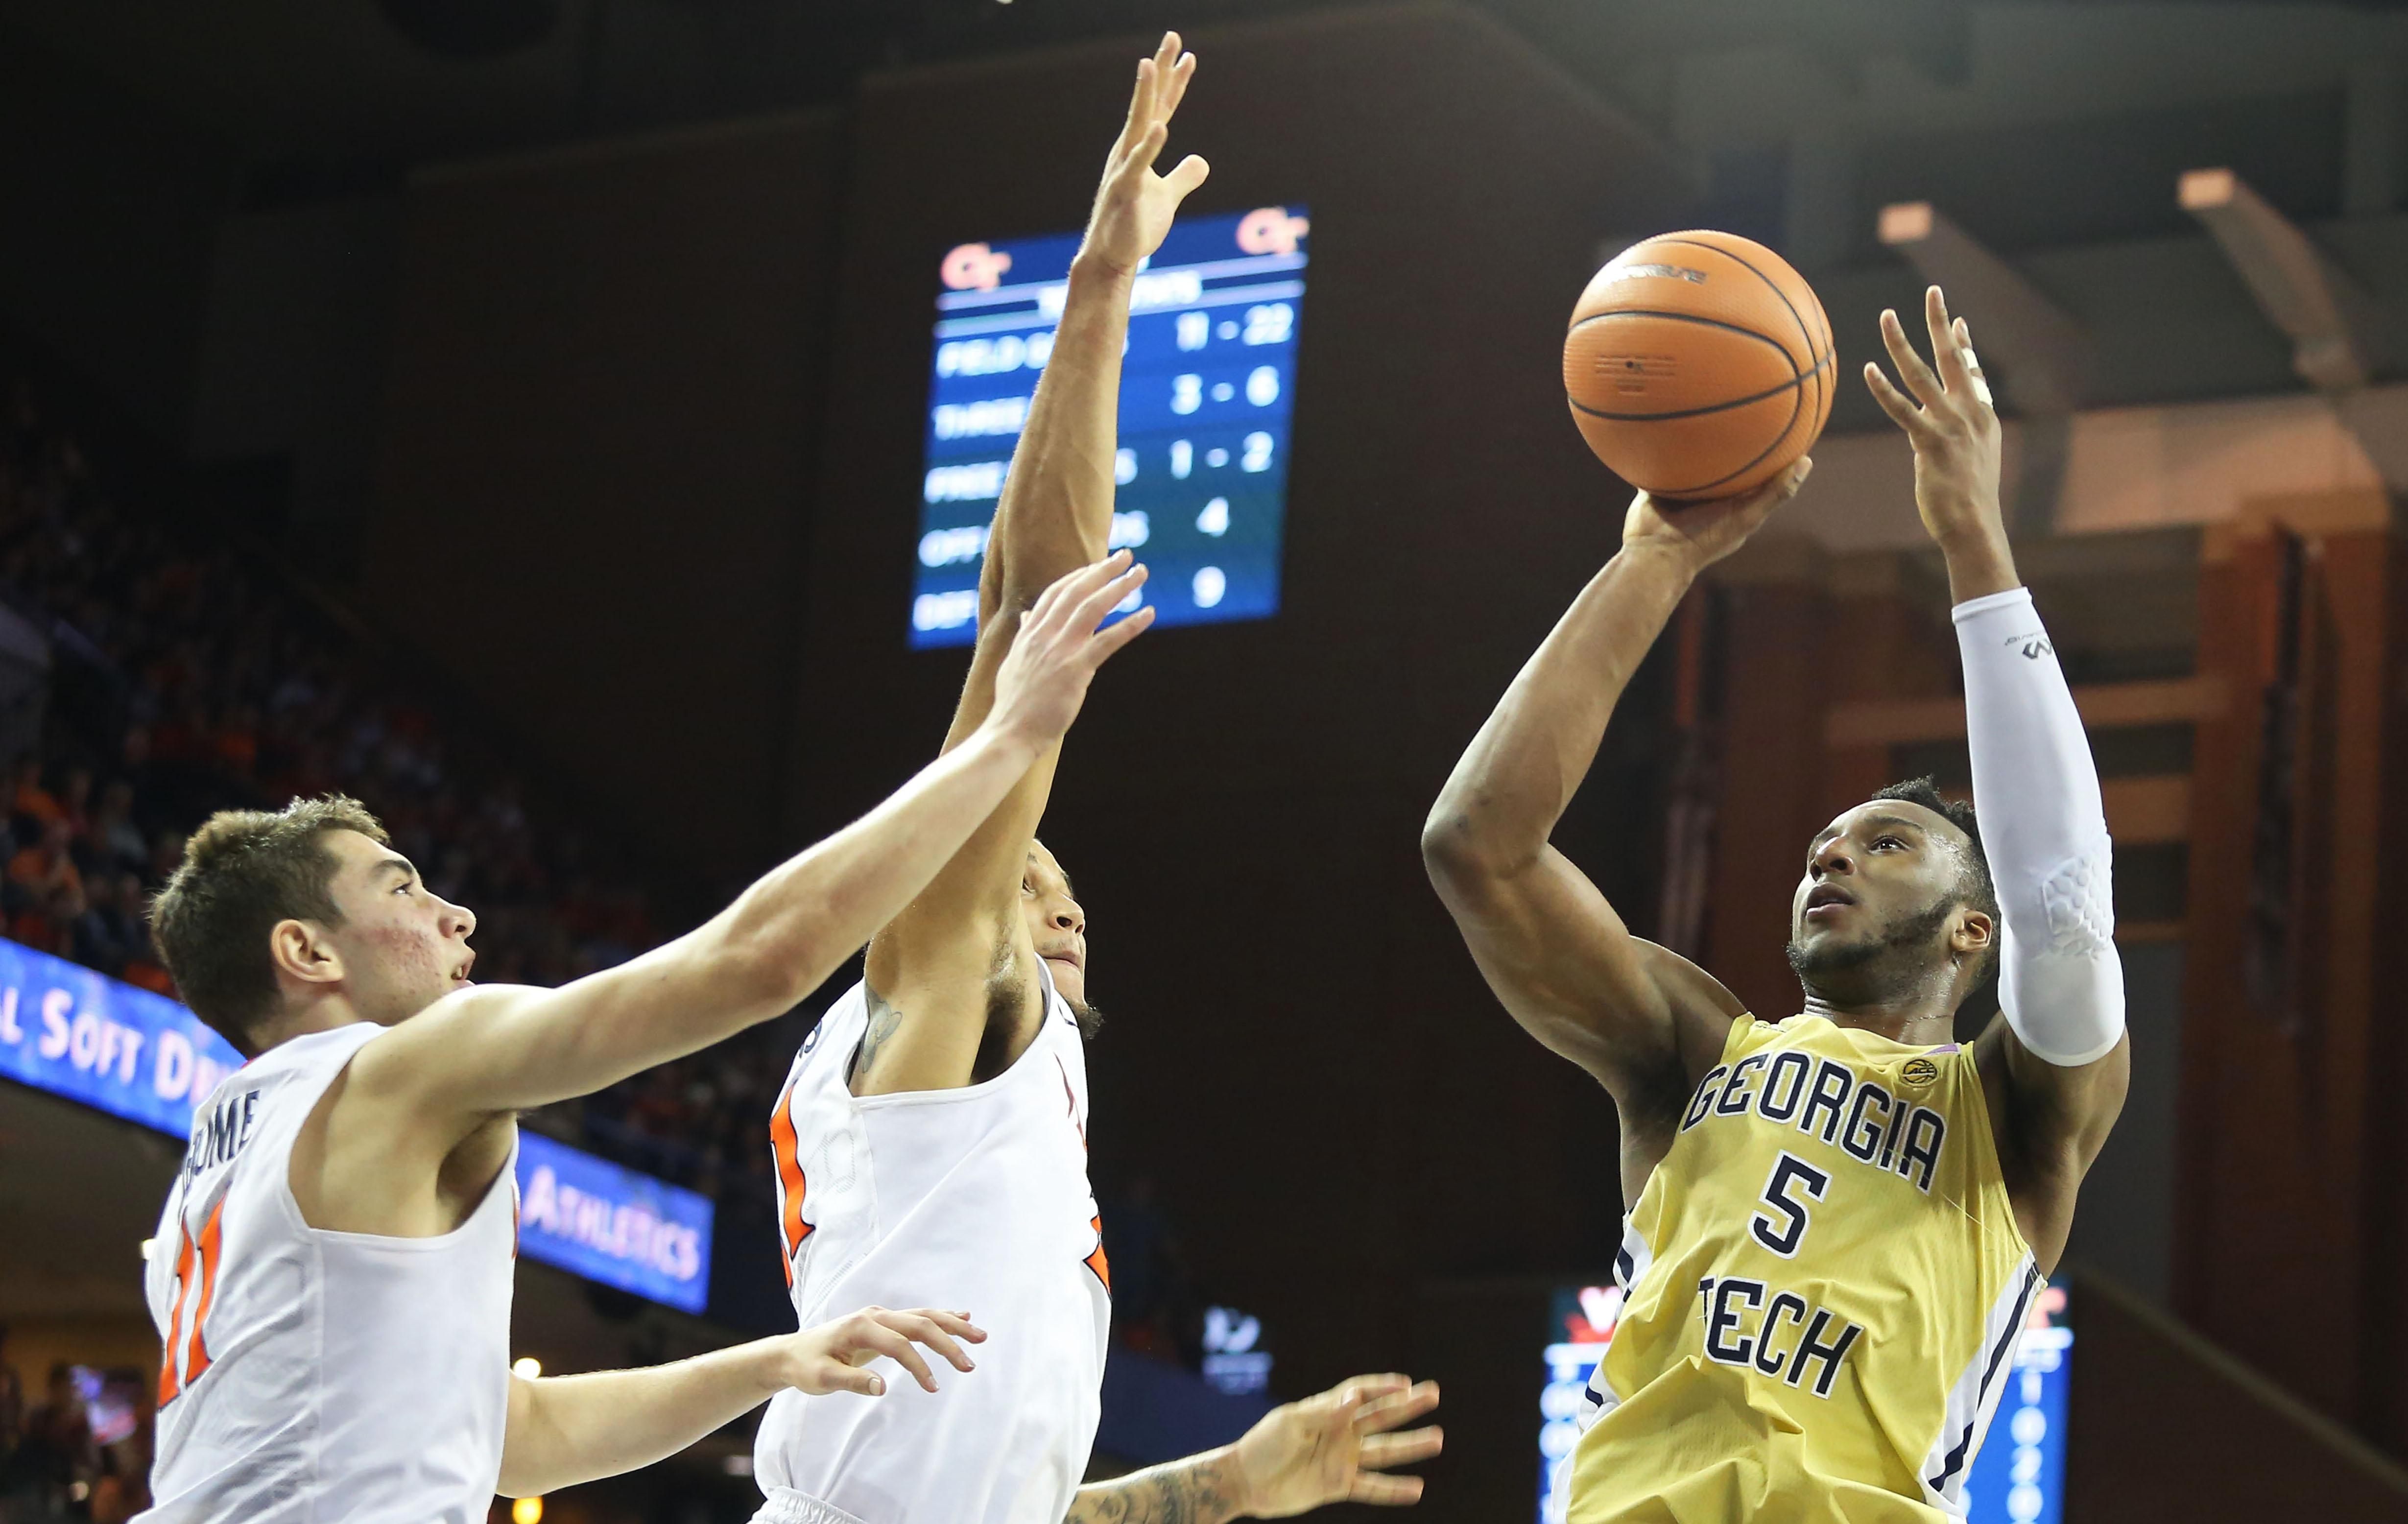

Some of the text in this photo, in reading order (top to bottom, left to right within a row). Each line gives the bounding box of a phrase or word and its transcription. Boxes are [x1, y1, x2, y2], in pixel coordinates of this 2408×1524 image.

[1176, 310, 1210, 352] 11
[1241, 302, 1295, 347] 22
[1170, 372, 1203, 415] 3
[1169, 438, 1194, 480] 1
[1241, 430, 1274, 473] 2
[1196, 497, 1230, 538] 4
[38, 988, 145, 1085] SOFT
[1680, 1049, 1948, 1196] GEORGIA
[1747, 1149, 1833, 1260] 5
[158, 1180, 233, 1411] 11
[1698, 1275, 1865, 1400] TECH
